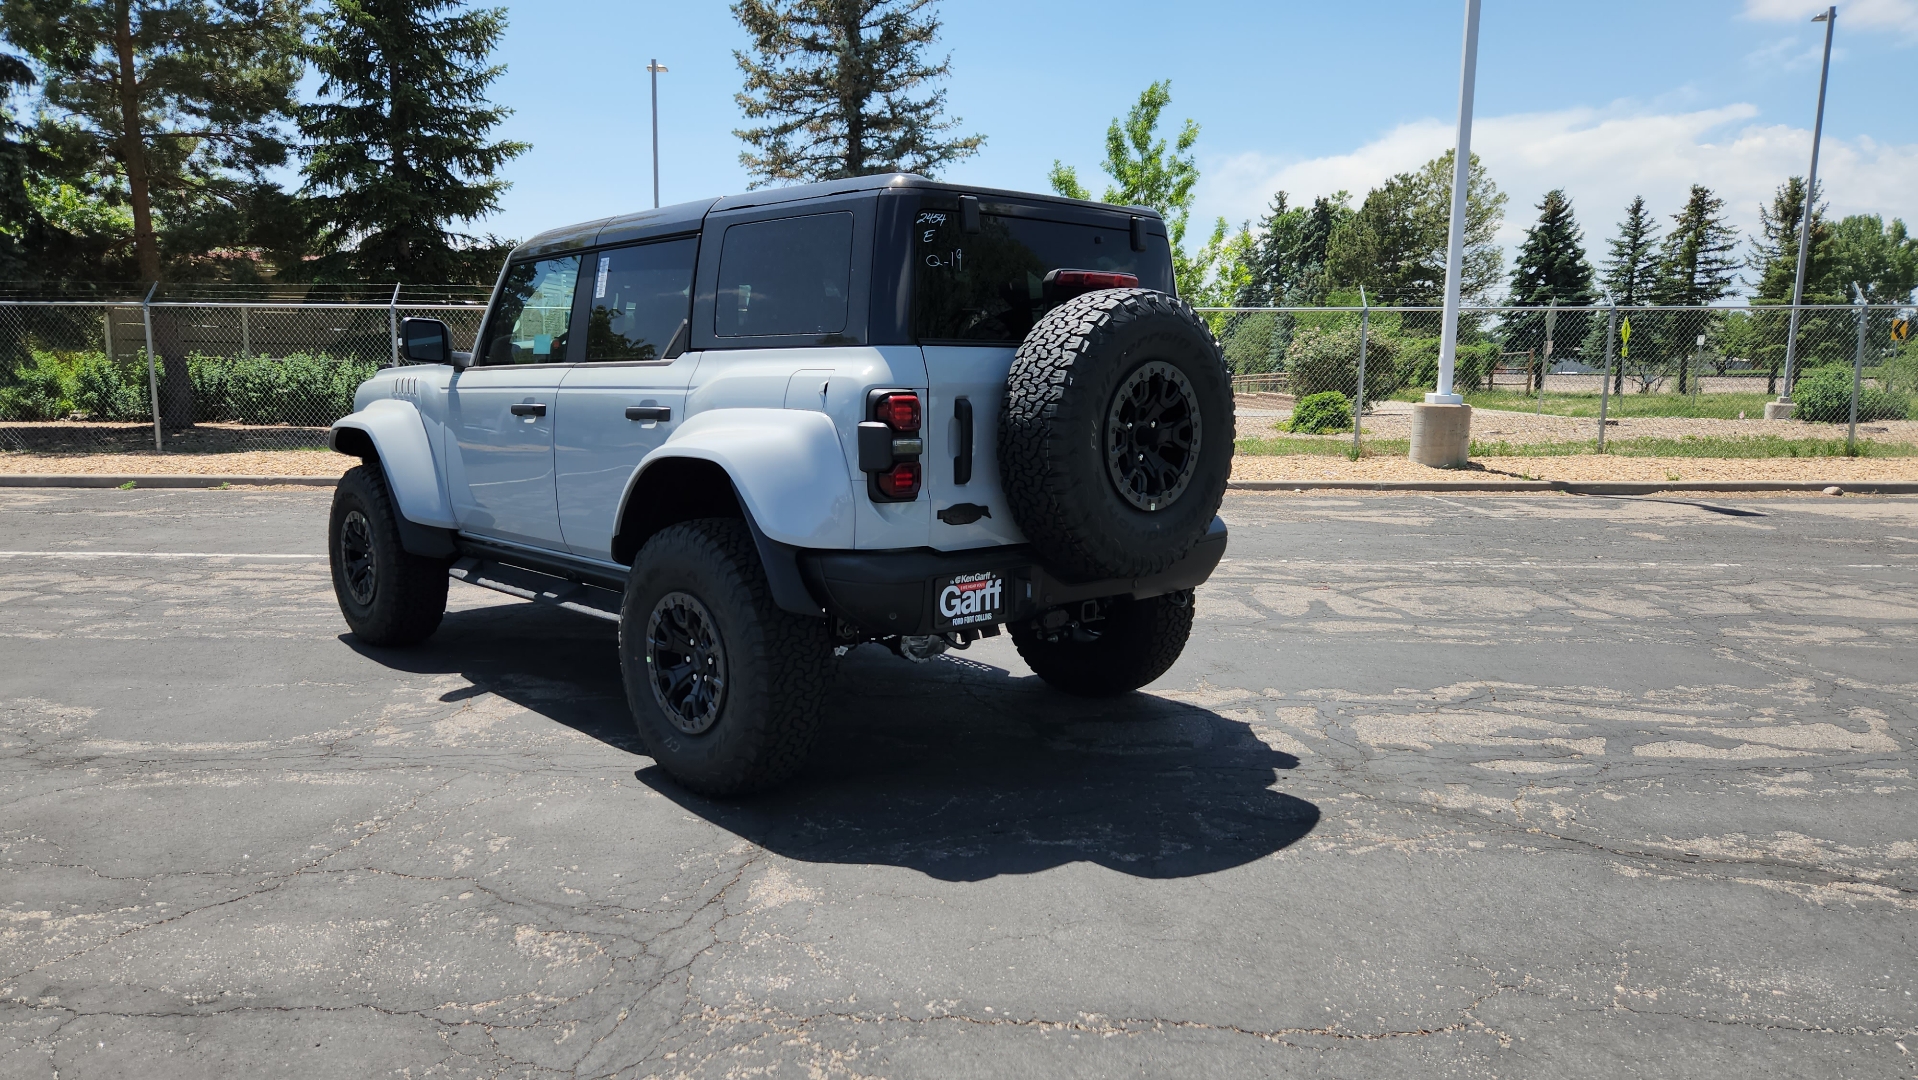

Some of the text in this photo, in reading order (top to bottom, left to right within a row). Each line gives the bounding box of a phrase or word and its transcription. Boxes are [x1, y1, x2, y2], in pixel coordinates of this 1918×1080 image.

[916, 213, 946, 226] 2454
[923, 229, 936, 242] E
[961, 572, 991, 583] Ken Garff
[940, 579, 1002, 618] Garff
[952, 618, 963, 626] FORD
[975, 613, 992, 622] COLLINS
